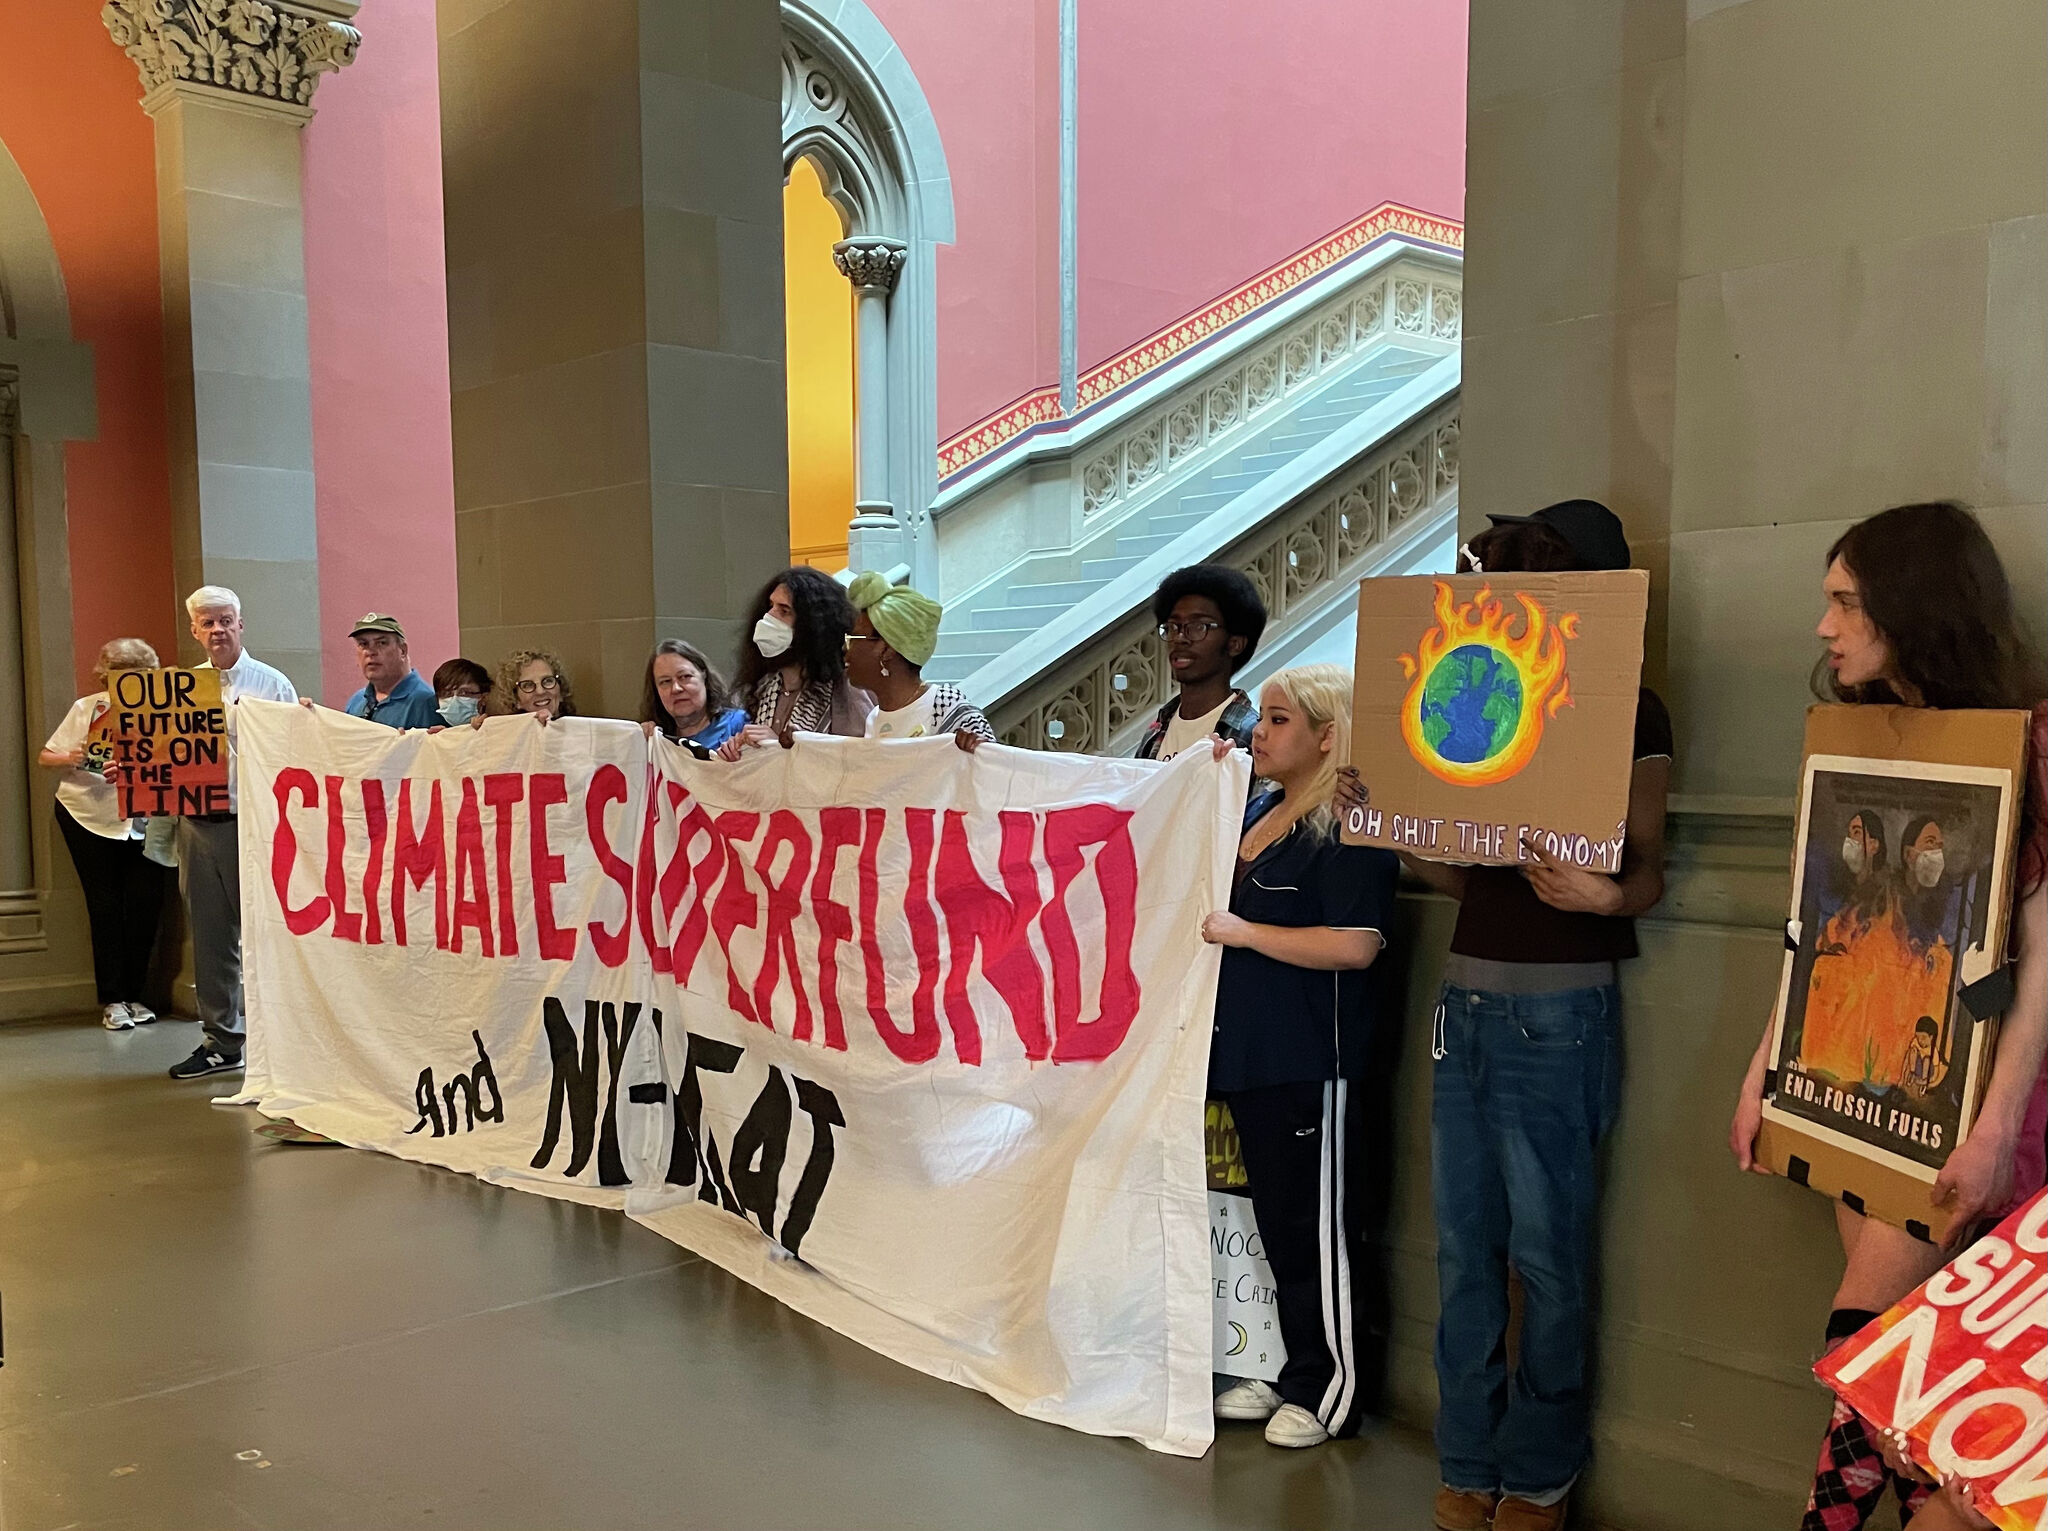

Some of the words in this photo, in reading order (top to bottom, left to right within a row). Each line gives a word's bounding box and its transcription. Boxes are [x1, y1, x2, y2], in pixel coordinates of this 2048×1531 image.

[116, 671, 196, 710] OUR
[120, 708, 225, 736] FUTURE
[116, 739, 153, 761] IS
[169, 737, 218, 766] ON
[122, 764, 172, 785] THE
[126, 784, 229, 818] LINE
[1348, 804, 1383, 838] OH
[1455, 820, 1507, 858] THE
[272, 767, 577, 961] CLIMATE
[404, 1029, 504, 1138] And
[1784, 1072, 1815, 1102] END
[1823, 1085, 1882, 1128] FOSSIL
[1888, 1108, 1943, 1150] FUELS
[1210, 1225, 1267, 1260] NOC
